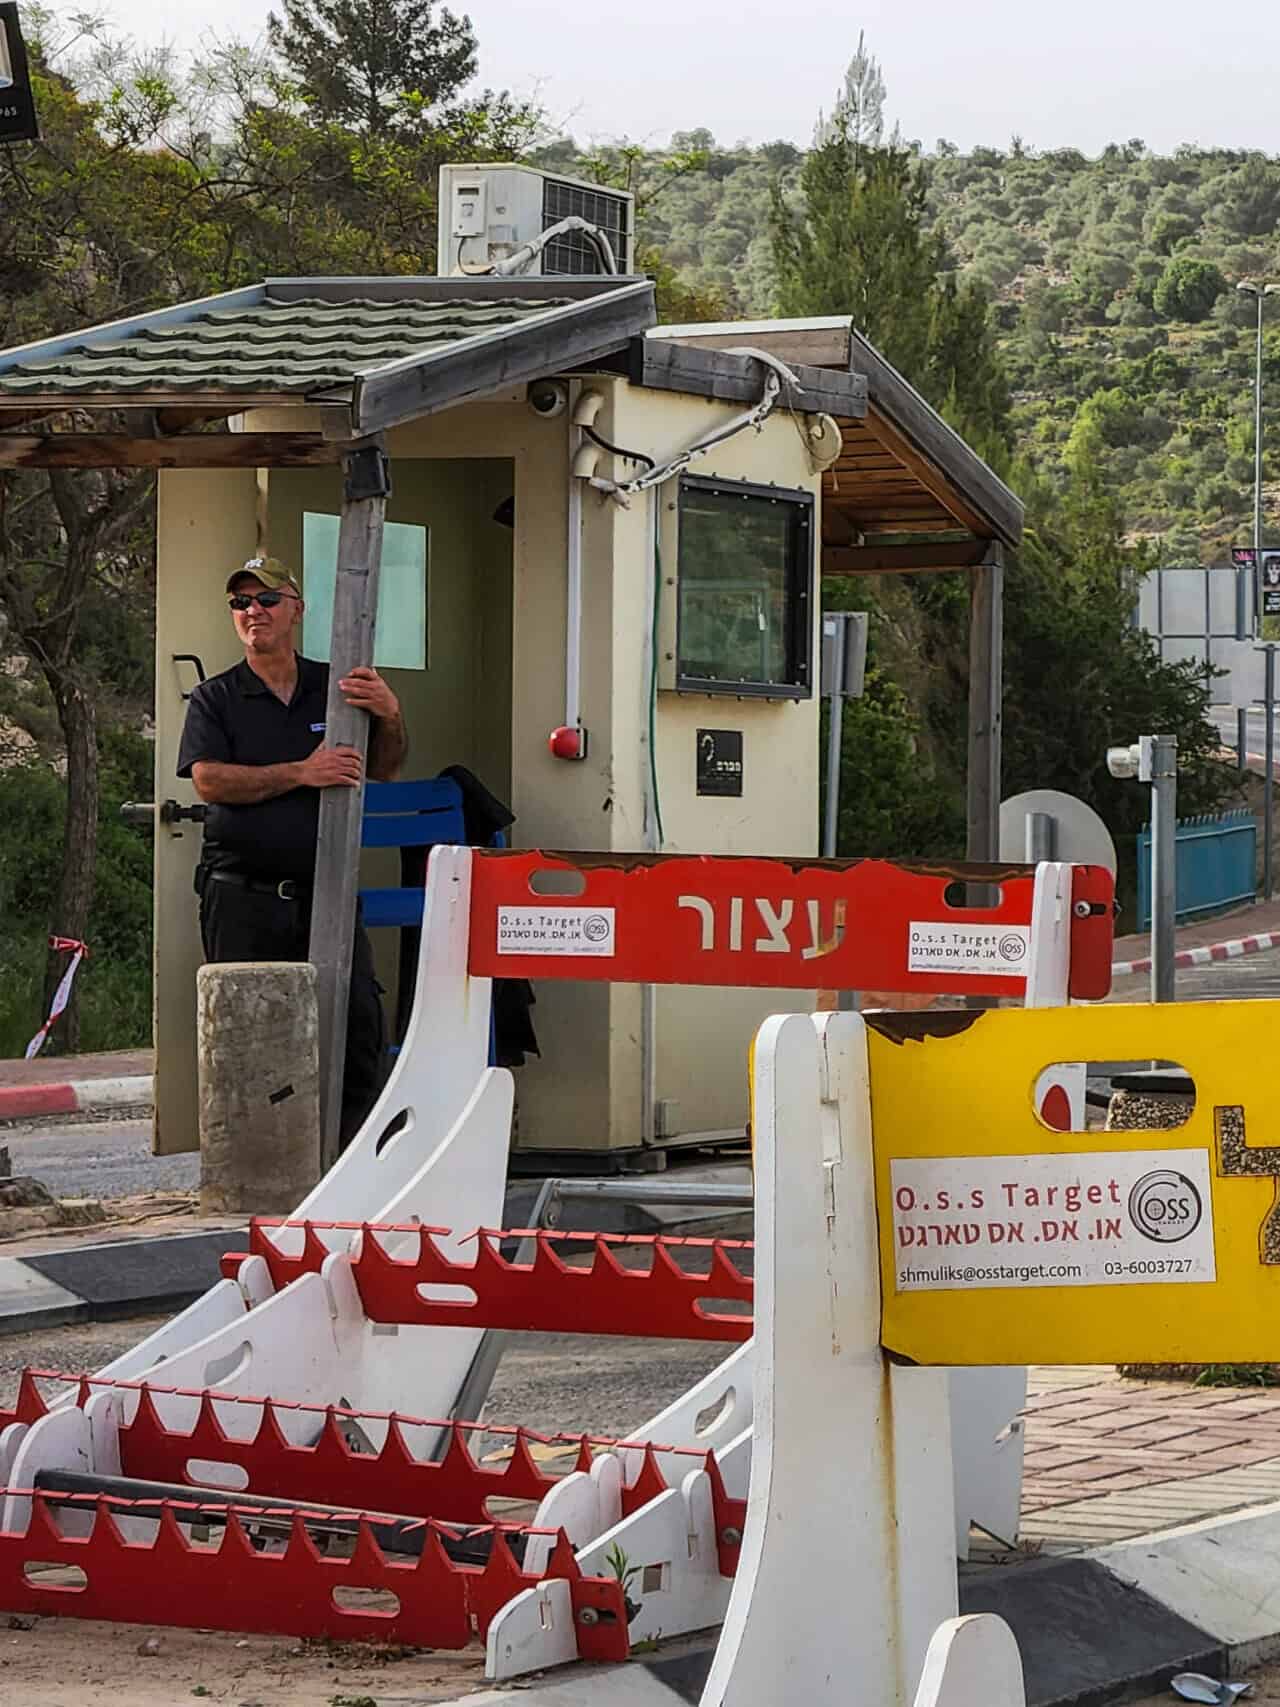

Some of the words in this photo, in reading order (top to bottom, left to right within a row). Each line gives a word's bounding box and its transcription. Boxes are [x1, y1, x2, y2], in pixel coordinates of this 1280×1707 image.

[539, 916, 581, 928] Target
[678, 895, 846, 960] עצור
[952, 934, 997, 947] Target
[896, 1186, 985, 1212] O.s.s
[1001, 1179, 1121, 1211] Target
[1144, 1198, 1190, 1221] OSS
[898, 1224, 981, 1248] טארגט
[987, 1222, 1025, 1244] אס
[1087, 1218, 1122, 1241] או.
[899, 1264, 1082, 1283] shmuliks@osstarget.com
[1104, 1260, 1193, 1276] 03-6003727
